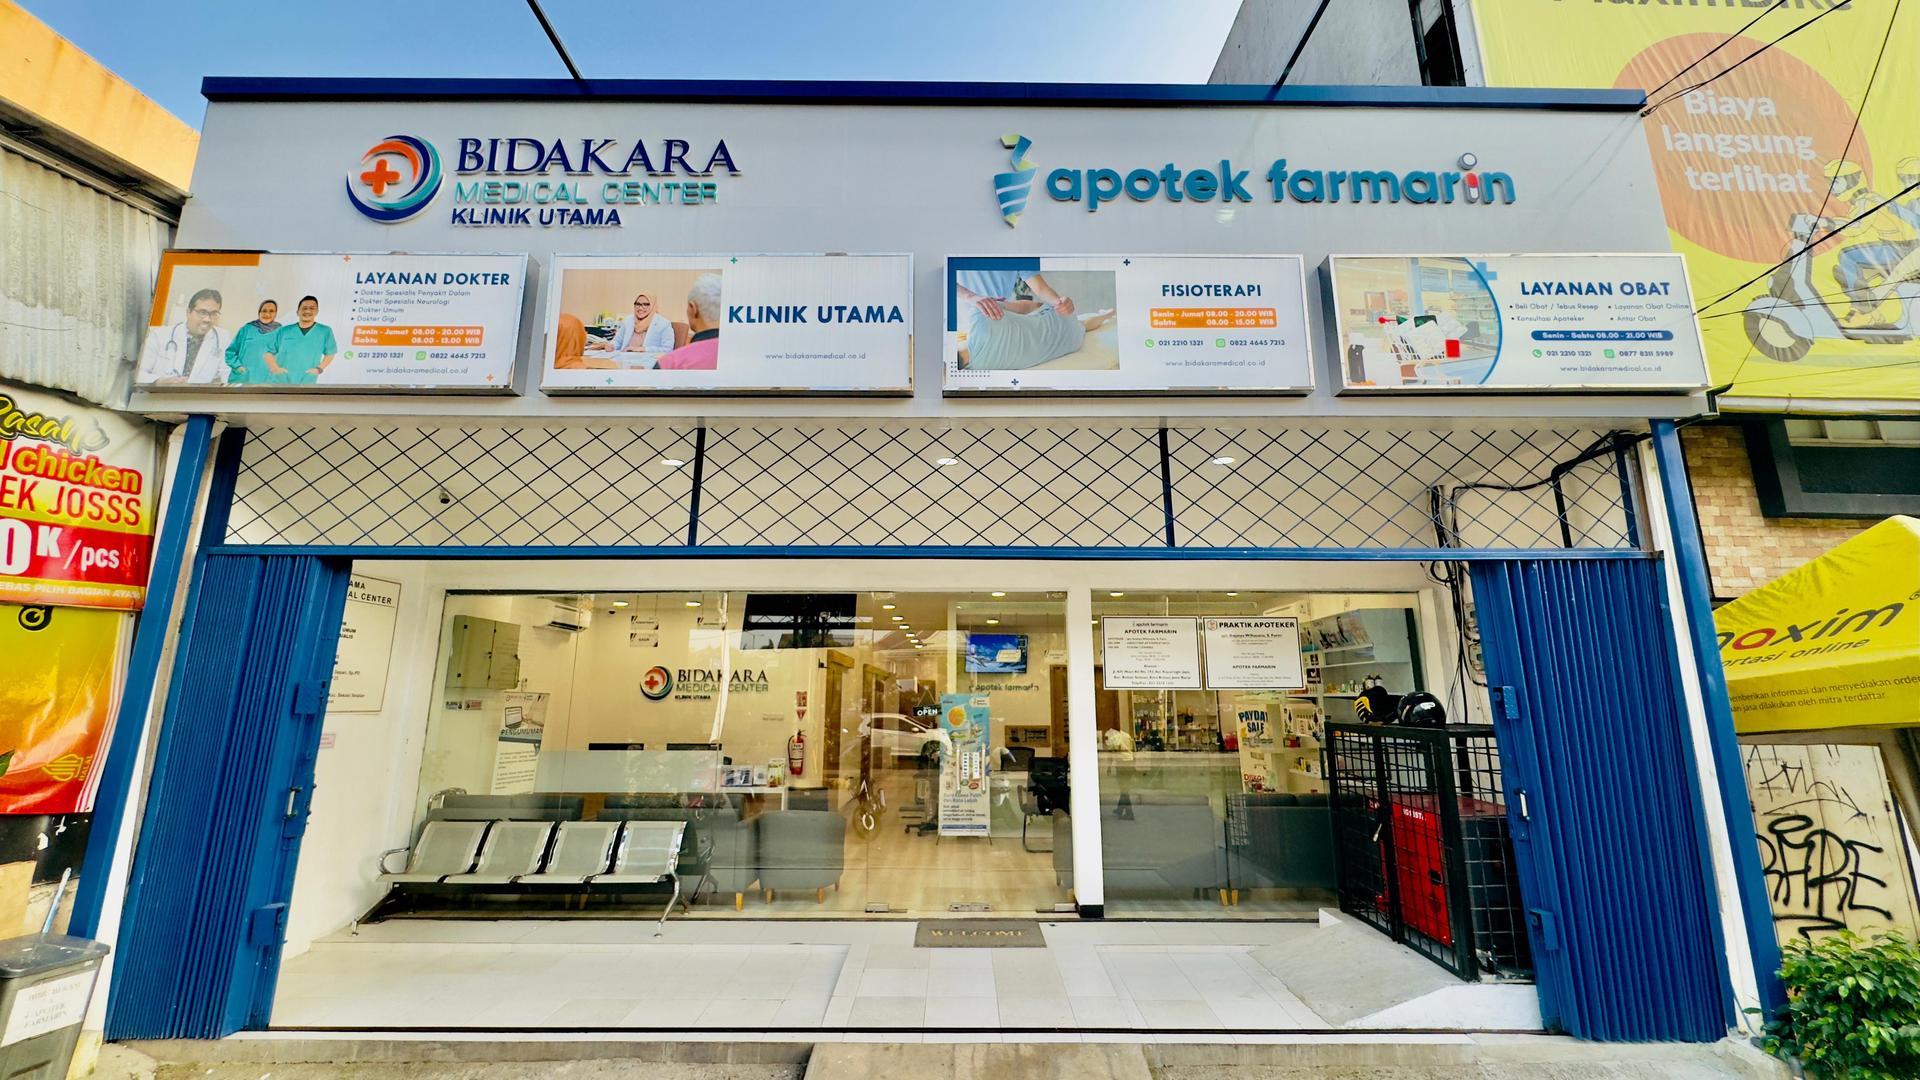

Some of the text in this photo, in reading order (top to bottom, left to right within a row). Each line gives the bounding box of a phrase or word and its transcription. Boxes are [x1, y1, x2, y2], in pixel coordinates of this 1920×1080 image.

[1685, 89, 1777, 121] Biaya
[1661, 125, 1818, 161] langsung
[455, 137, 741, 176] BIDAKARA
[1046, 152, 1516, 212] apotek farmarin
[1684, 164, 1813, 193] terlihat
[455, 182, 718, 206] MEDICAL CENTER
[451, 208, 622, 227] KLINIK UTAMA
[356, 272, 510, 285] LAYANAN DOKTER
[418, 290, 447, 298] Penyakit
[1162, 284, 1261, 297] FISIOTERAPI
[1520, 282, 1670, 296] LAYANAN OBAT
[728, 305, 904, 323] KLINIK UTAMA
[765, 352, 866, 360] www.bidakaramedical.co.id
[16, 446, 140, 493] chicken
[47, 485, 142, 527] JOSSS
[361, 592, 392, 605] CENTER
[1789, 638, 1870, 658] online
[728, 683, 768, 692] CENTER
[1771, 686, 1810, 698] informasi
[1811, 685, 1828, 695] dan
[1829, 678, 1892, 693] menyediakan
[917, 708, 938, 717] OPEN
[1743, 704, 1758, 714] jasa
[1759, 699, 1796, 711] dilakukan
[1798, 698, 1817, 707] oleh
[1818, 695, 1843, 705] mitra
[500, 727, 544, 736] PENGUMUMAN
